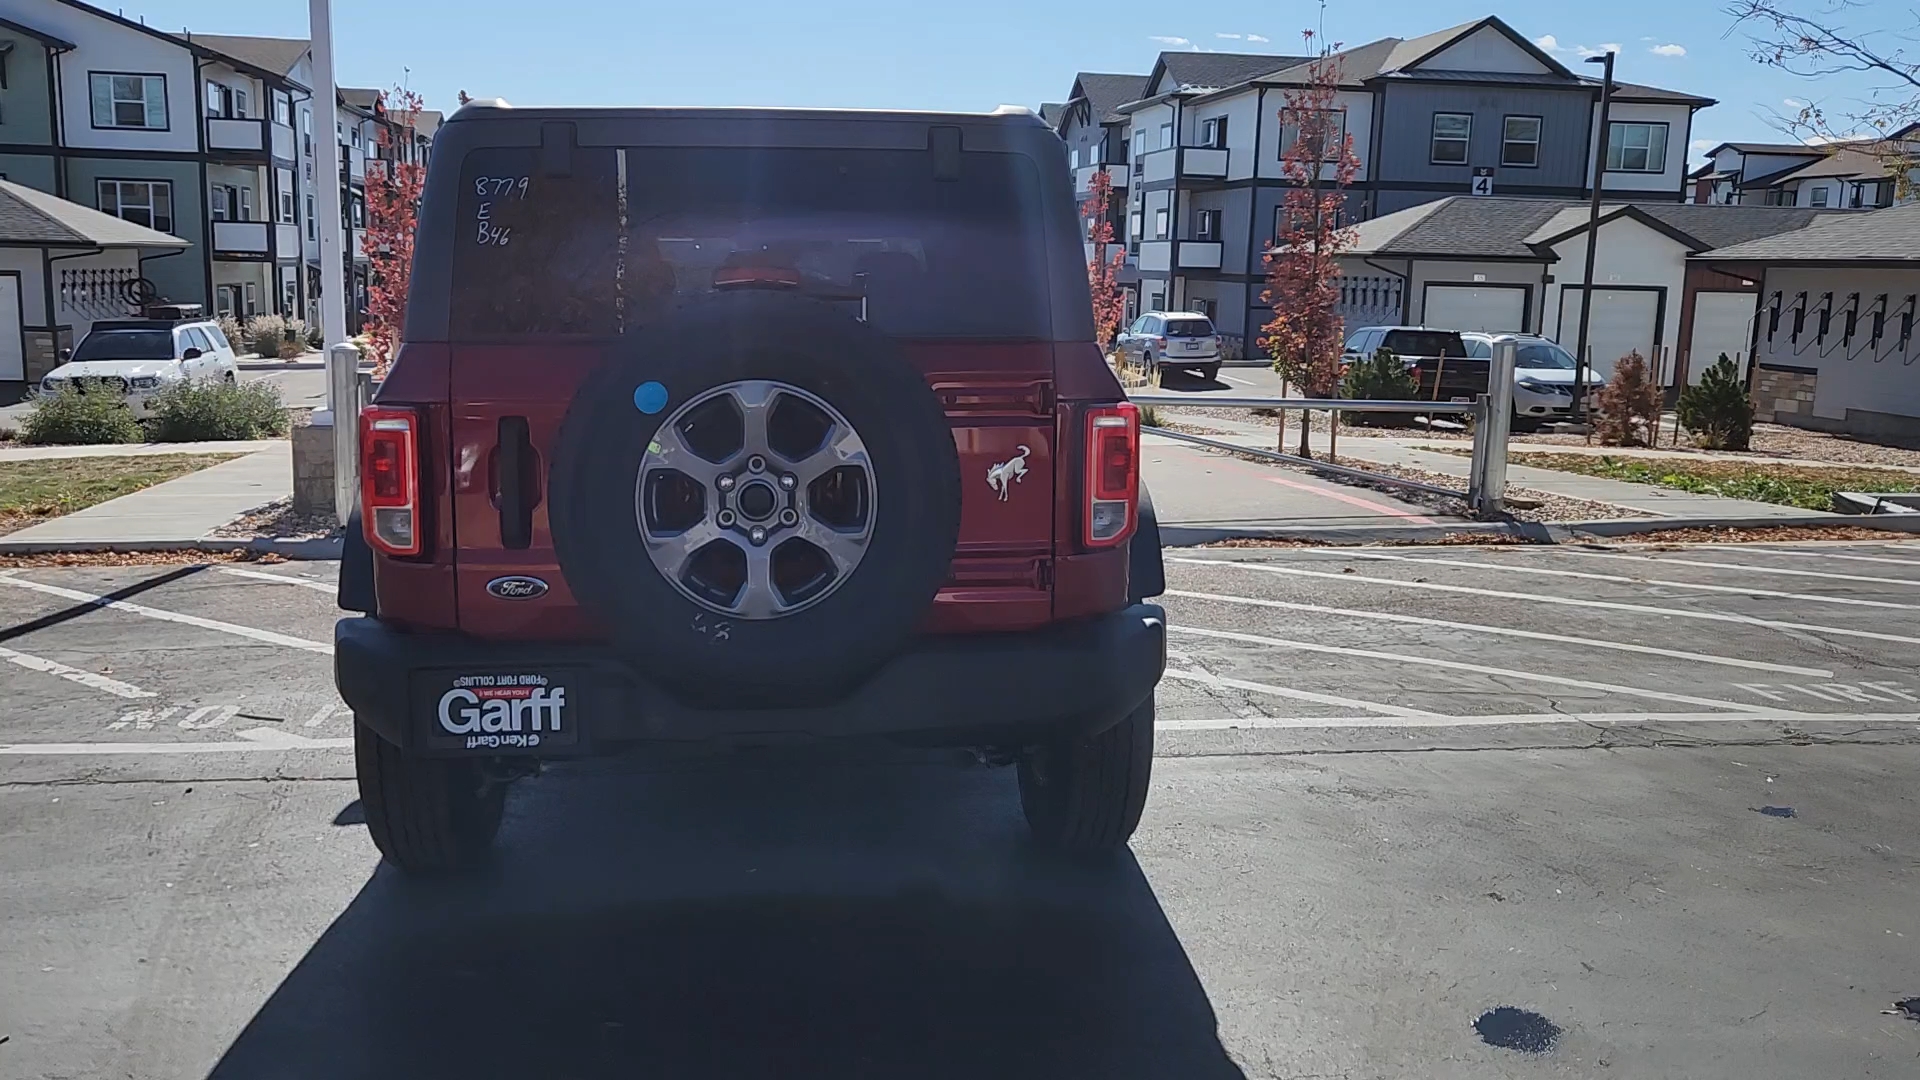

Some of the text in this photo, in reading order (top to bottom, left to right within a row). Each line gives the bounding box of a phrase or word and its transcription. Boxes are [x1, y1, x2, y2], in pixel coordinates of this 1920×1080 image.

[474, 176, 529, 200] 8779
[1475, 177, 1489, 195] 4
[477, 202, 491, 220] E
[476, 221, 511, 246] B46
[500, 581, 534, 596] Ford
[460, 674, 542, 687] FORD FORT COLLINS
[495, 689, 511, 697] HEAR
[438, 686, 565, 735] Garff
